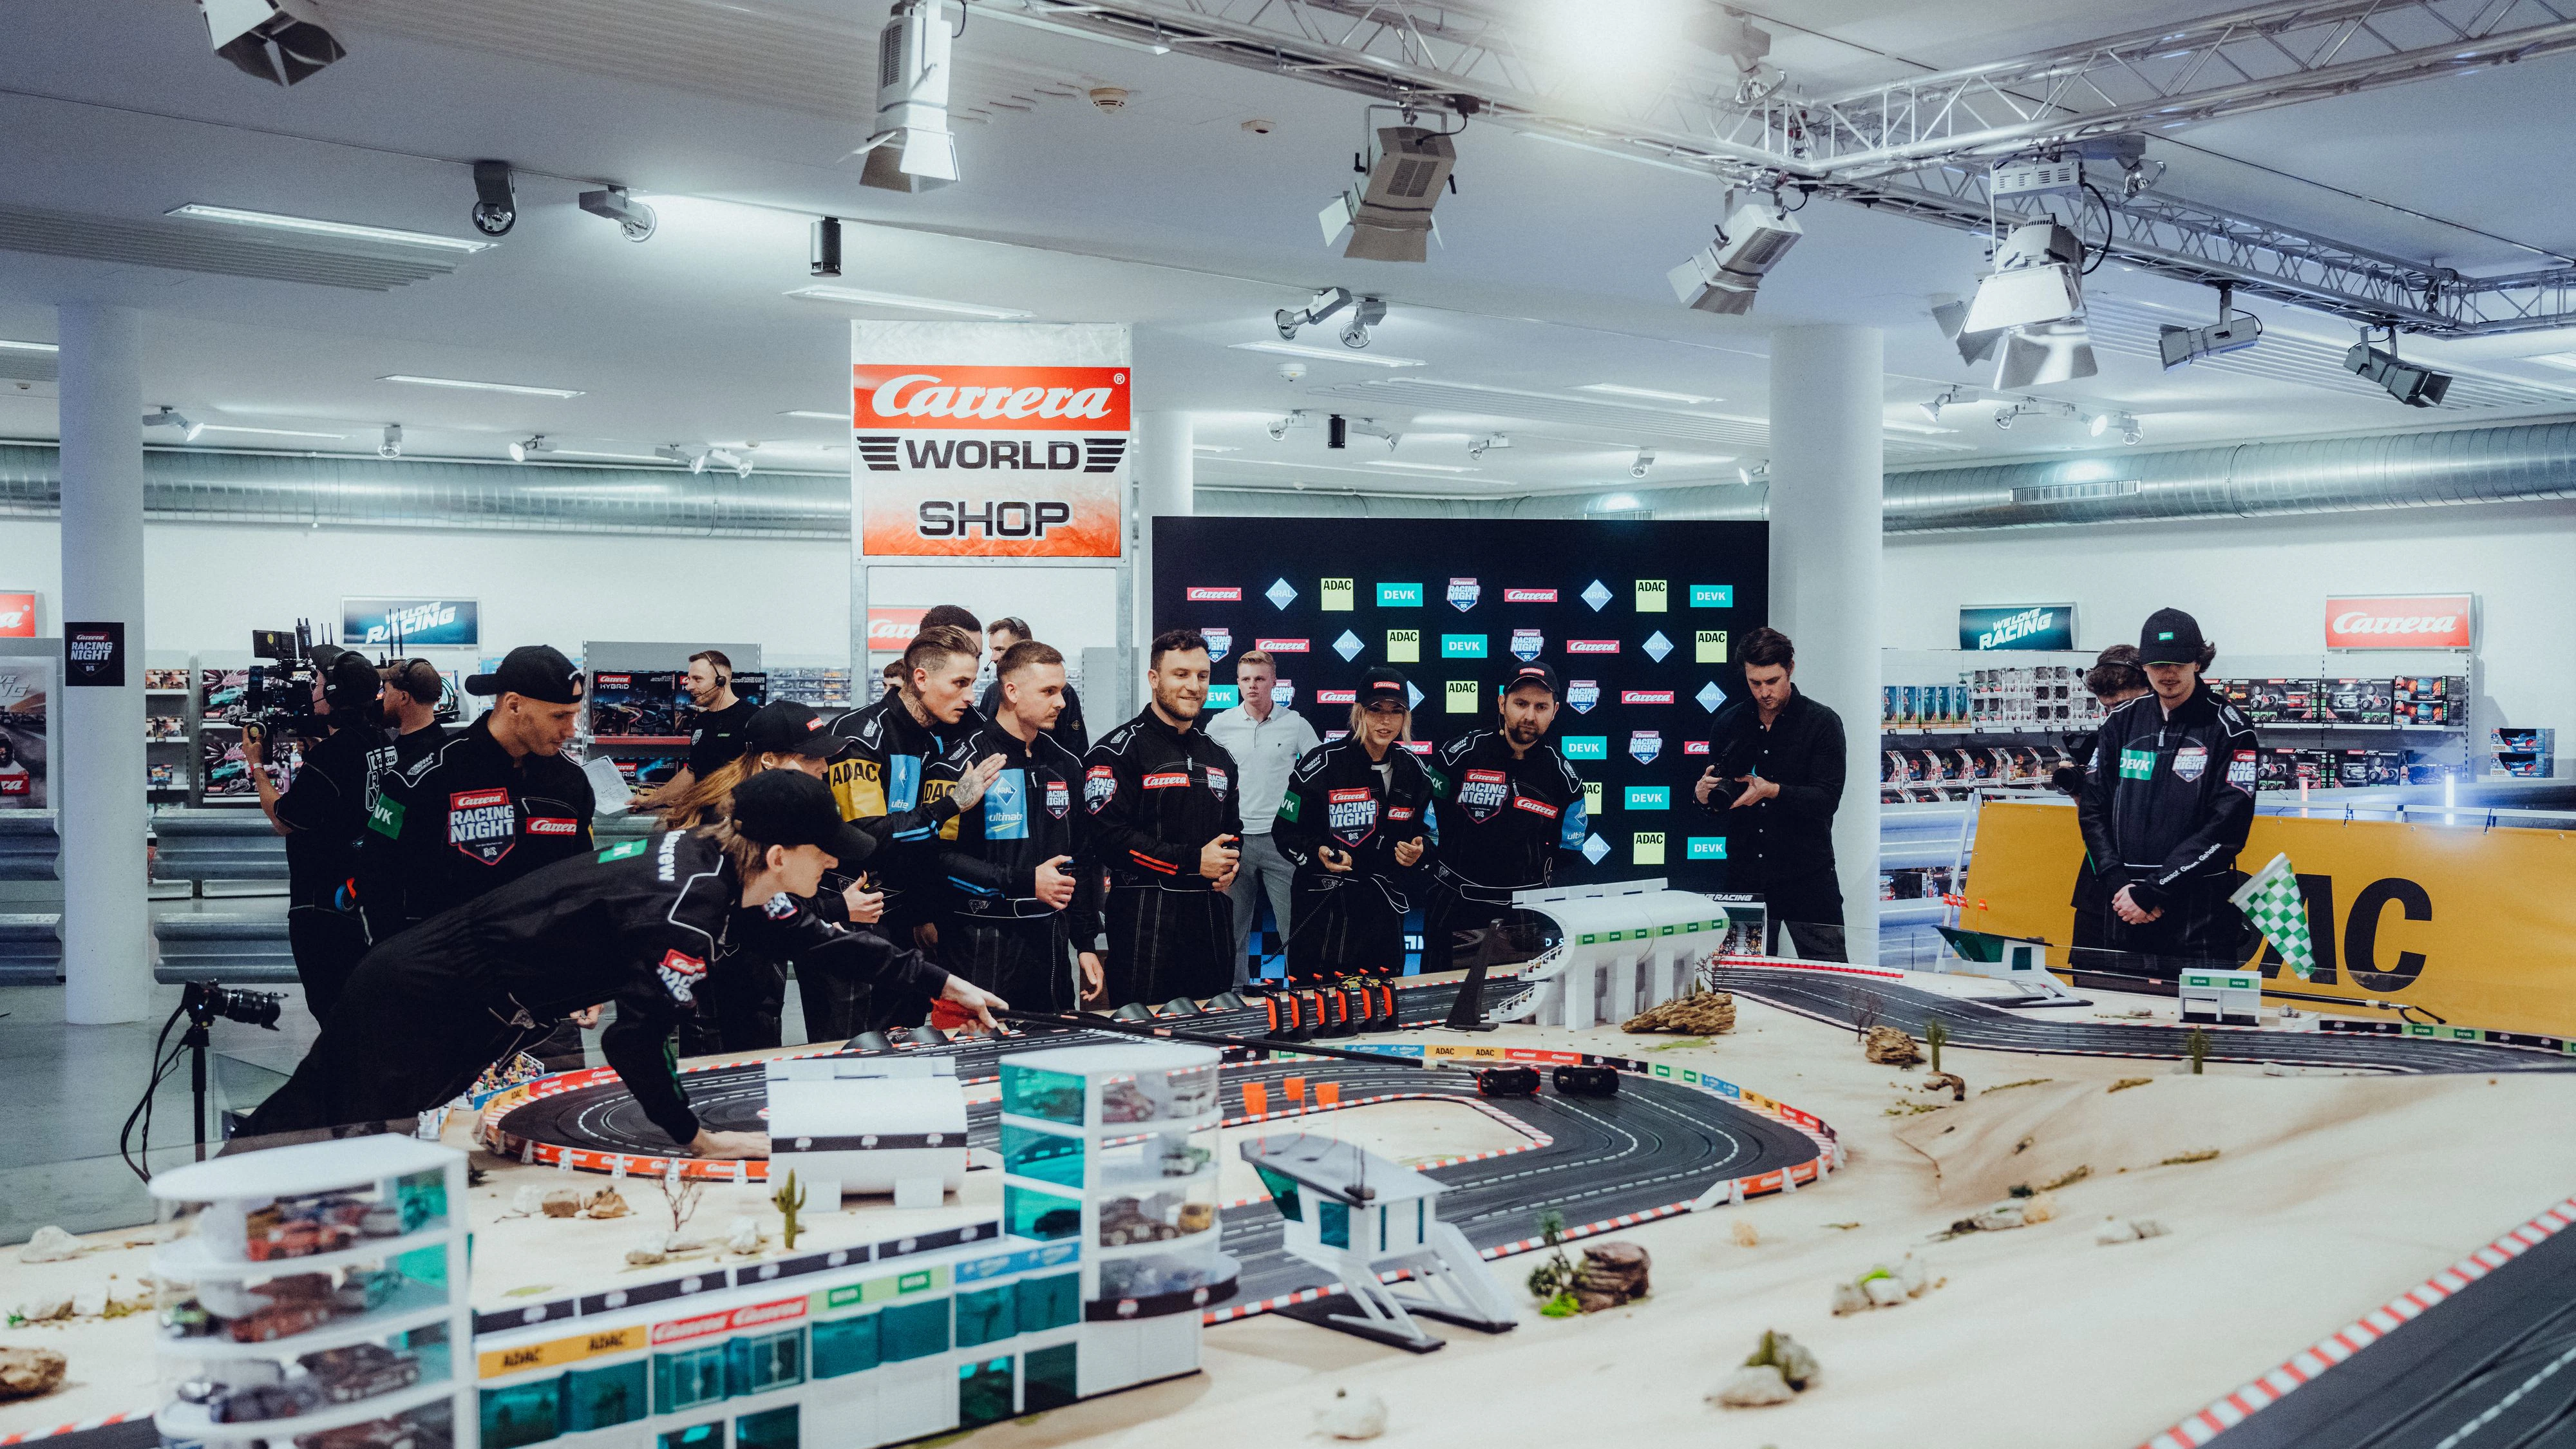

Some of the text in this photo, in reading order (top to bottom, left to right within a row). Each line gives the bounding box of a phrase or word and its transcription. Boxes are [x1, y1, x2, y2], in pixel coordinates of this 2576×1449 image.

[905, 439, 1079, 470] WORLD
[919, 501, 1070, 537] SHOP
[1323, 580, 1351, 591] ADAC
[1638, 582, 1665, 592] ADAC
[1191, 589, 1238, 599] Carrera
[1384, 590, 1416, 600] DEVK
[1508, 590, 1554, 600] Carrera
[1696, 592, 1726, 600] DEVK
[407, 601, 442, 619] LOVE
[1993, 608, 2041, 631] WE LOVE
[2333, 611, 2458, 634] Carrera
[366, 606, 457, 644] RACING
[1979, 612, 2053, 650] RACING
[1389, 632, 1417, 642] ADAC
[1698, 632, 1725, 643] ADAC
[71, 641, 113, 651] RACING
[1259, 640, 1306, 650] Carrera
[1449, 641, 1481, 650] DEVK
[1570, 642, 1617, 652] Carrera
[71, 650, 112, 661] NIGHT
[1448, 683, 1476, 693] ADAC
[1208, 692, 1231, 701] EVK
[1567, 694, 1596, 703] NIGHT
[1625, 692, 1671, 702] Carrera
[1569, 743, 1600, 753] DEVK
[1629, 744, 1660, 753] NIGHT
[833, 762, 878, 787] ADAC
[1208, 774, 1228, 783] RACING
[1469, 773, 1501, 782] Carrera
[2227, 770, 2256, 782] NIG
[1143, 776, 1187, 786] Carrera
[1209, 780, 1227, 790] NIGHT
[1462, 781, 1508, 795] RACING
[459, 792, 504, 807] Carrera
[1332, 793, 1365, 801] Carrera
[1458, 791, 1505, 806] NIGHT
[1632, 793, 1662, 803] DEVK
[1517, 799, 1557, 817] Carrera
[450, 804, 515, 826] RACING
[989, 811, 1023, 822] ultimate
[450, 818, 515, 844] NIGHT
[1635, 834, 1663, 844] ADAC
[1694, 844, 1723, 853] DEVK
[1435, 1047, 1455, 1056] ADAC
